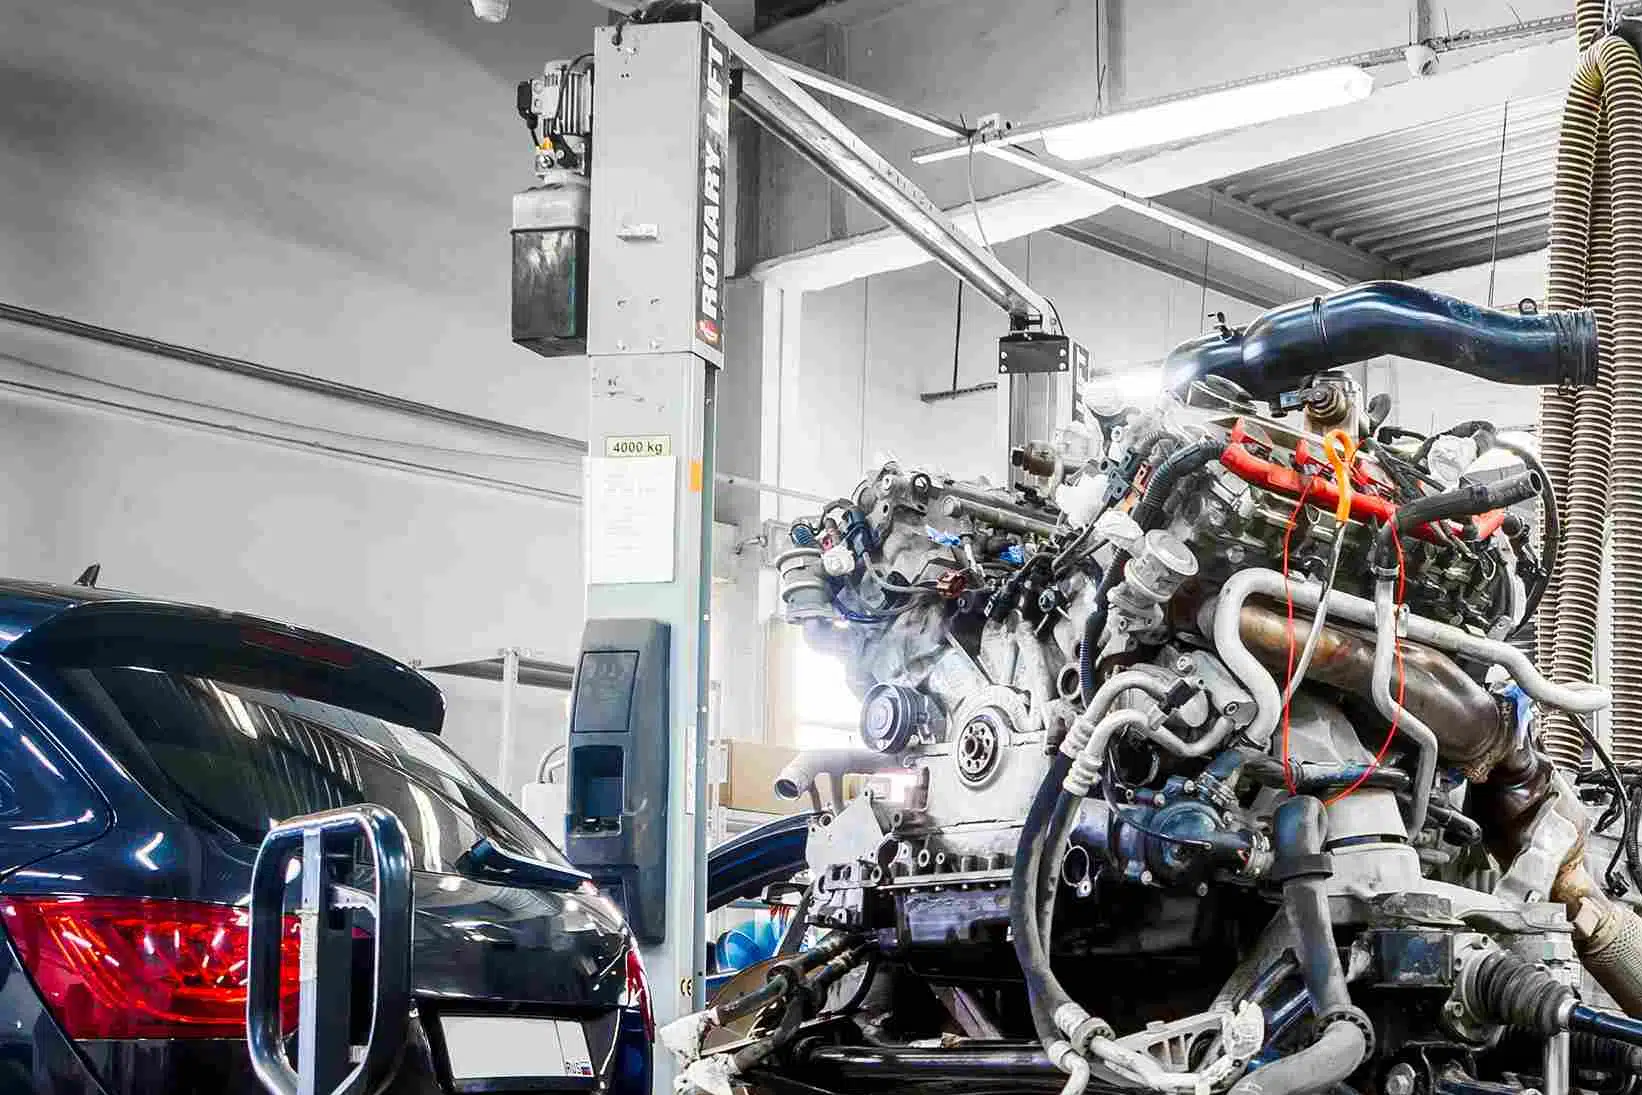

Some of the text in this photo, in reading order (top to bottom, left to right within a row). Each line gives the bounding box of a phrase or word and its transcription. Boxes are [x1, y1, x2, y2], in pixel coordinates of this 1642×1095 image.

[701, 37, 723, 320] ROTARY LIFT
[612, 441, 663, 456] 4000 kg
[680, 978, 692, 997] CE
